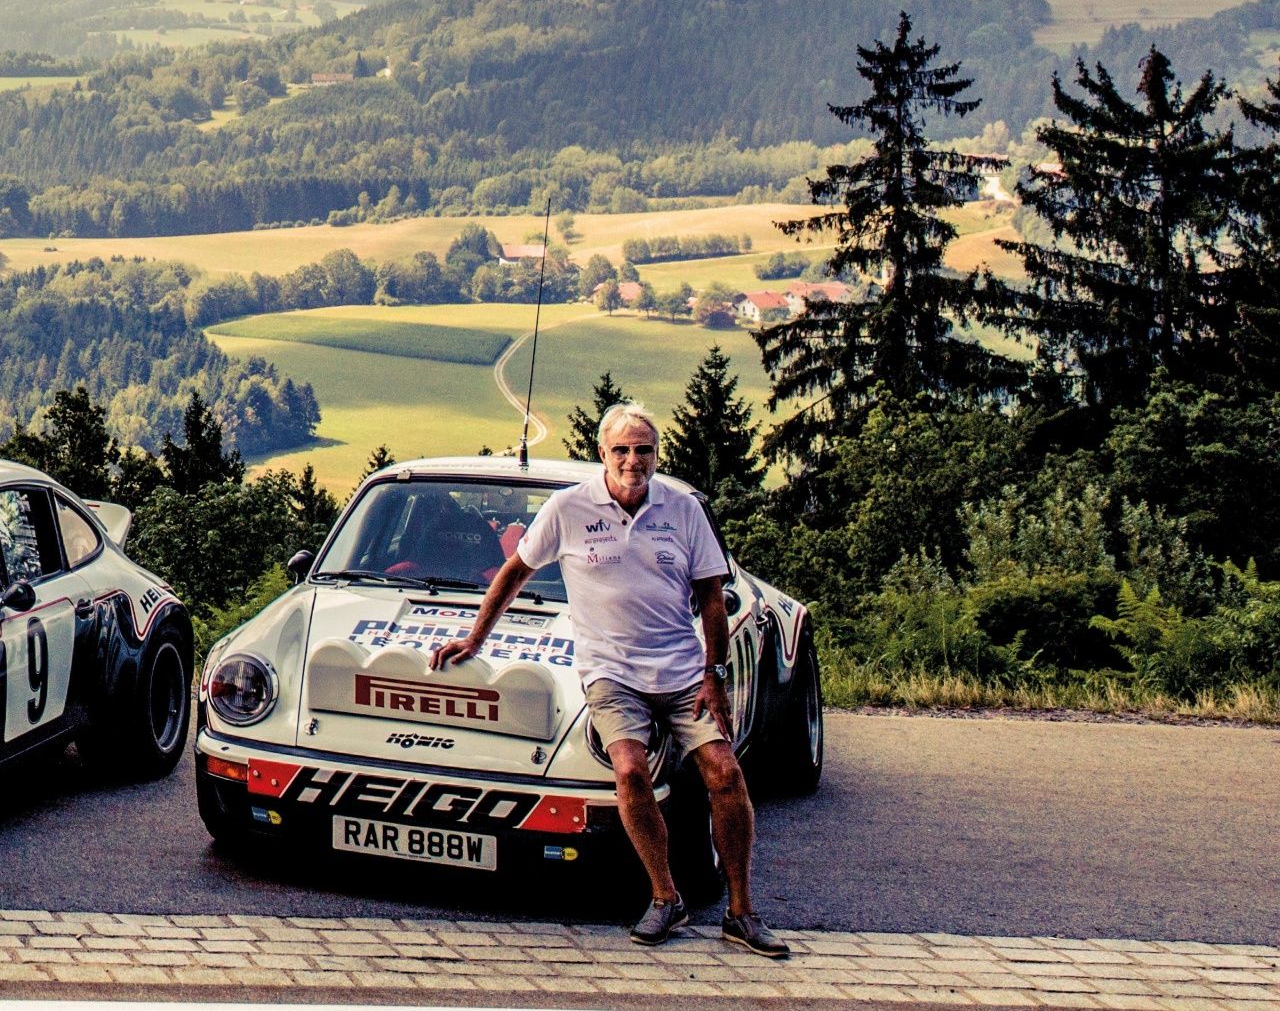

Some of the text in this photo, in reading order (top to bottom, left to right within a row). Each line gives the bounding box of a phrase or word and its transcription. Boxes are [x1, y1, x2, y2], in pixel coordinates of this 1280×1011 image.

[585, 519, 610, 532] wfv
[27, 617, 48, 724] 9
[355, 674, 500, 721] PIRELLI
[288, 767, 540, 827] HEIGO
[344, 821, 482, 862] RAR 888W
